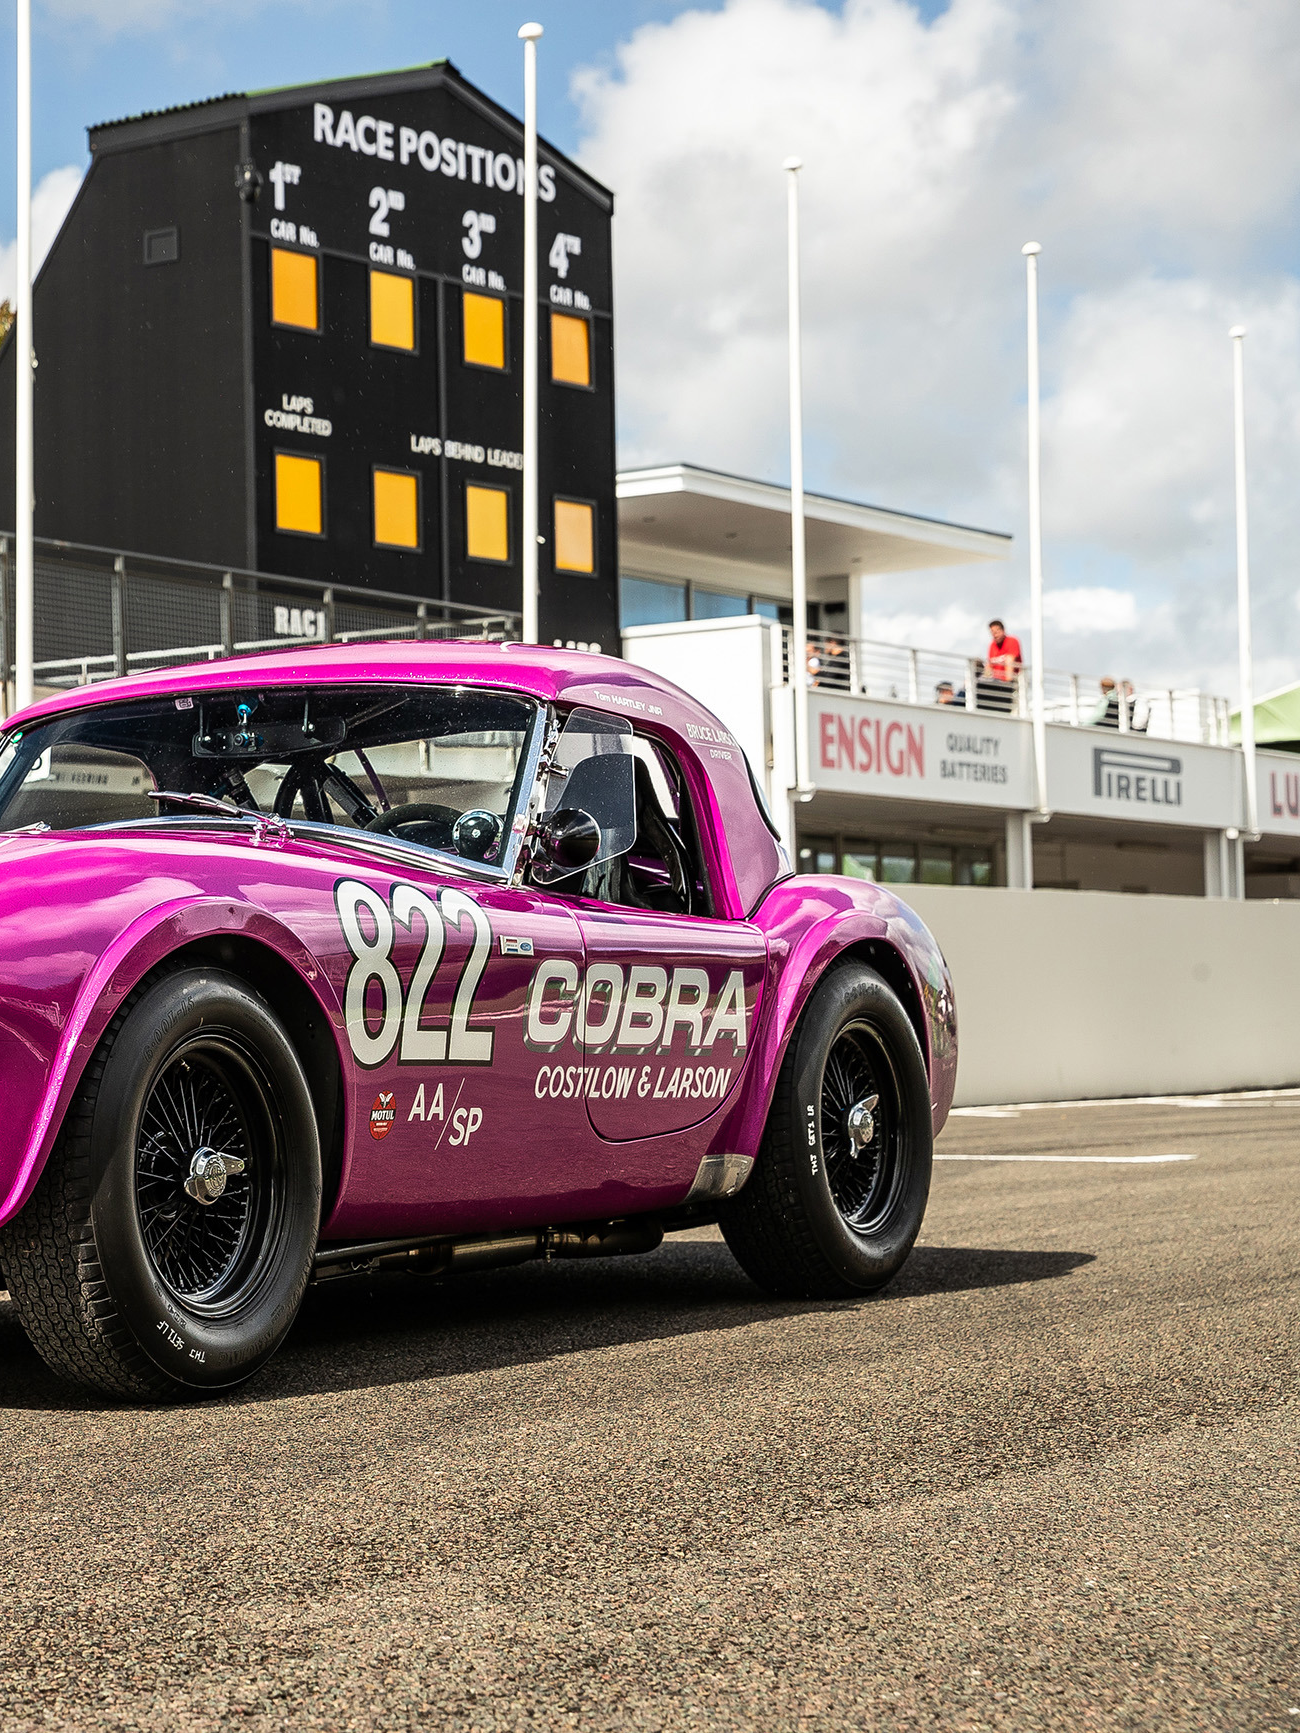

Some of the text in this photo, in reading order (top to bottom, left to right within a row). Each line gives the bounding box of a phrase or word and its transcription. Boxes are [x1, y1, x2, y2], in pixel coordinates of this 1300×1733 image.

[313, 102, 395, 162] RACE
[270, 218, 297, 243] CAR
[369, 242, 394, 265] CAR
[462, 263, 487, 287] CAR
[549, 284, 573, 307] CAR
[282, 393, 314, 415] LAPS
[264, 409, 333, 437] COMPLETED
[411, 434, 524, 471] LAPS BEHIND LEADE
[611, 695, 646, 712] HARTLEY
[685, 723, 713, 742] BRUCE
[946, 732, 1001, 757] QUALITY
[709, 749, 733, 761] DRIVER
[819, 711, 925, 780] ENSIGN
[940, 759, 1008, 786] BATTERIES
[1092, 747, 1183, 806] PIRELLI
[333, 877, 496, 1071] 822
[525, 958, 748, 1056] COBRA
[534, 1065, 732, 1099] COSTILOW & LARSON
[370, 1109, 395, 1121] MOTUL
